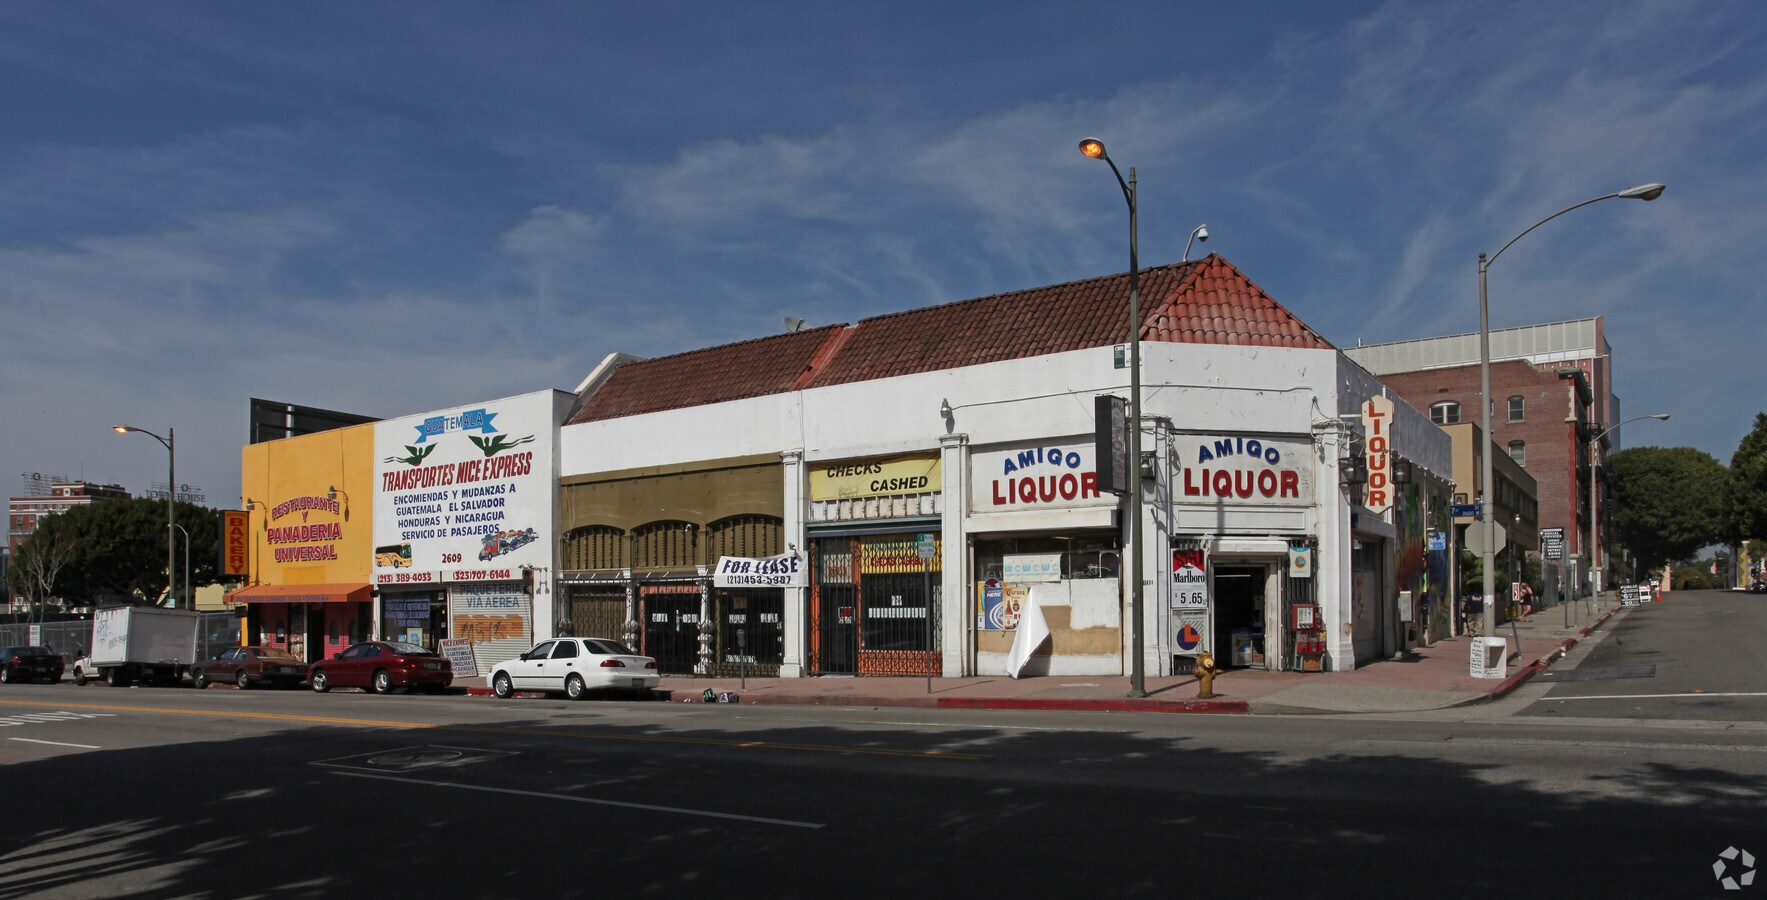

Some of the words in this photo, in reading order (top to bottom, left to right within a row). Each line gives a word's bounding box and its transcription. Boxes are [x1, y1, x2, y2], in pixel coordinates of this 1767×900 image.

[425, 412, 483, 433] GUATEMALA
[1198, 437, 1280, 464] AMIGO
[1368, 402, 1386, 506] LIQUOR
[827, 462, 882, 478] CHECKS
[1003, 447, 1081, 475] AMIGO
[382, 463, 456, 492] TRANSPORTES
[456, 459, 482, 487] NICE
[483, 451, 533, 481] EXPRESS
[870, 476, 928, 492] CASHED
[992, 471, 1101, 506] LIQUOR
[1184, 468, 1299, 499] LIQUOR
[177, 493, 206, 502] HOUSE
[394, 491, 448, 505] ENCOMIENDAS
[452, 490, 458, 500] Y
[461, 484, 505, 498] MUDANZAS
[509, 484, 516, 493] A
[271, 496, 340, 521] RESTAURANTE
[396, 504, 442, 516] GUATEMALA
[449, 502, 459, 512] EL
[461, 498, 505, 511] SALVADOR
[302, 511, 309, 522] Y
[398, 516, 440, 528] HONDURAS
[444, 516, 451, 525] Y
[455, 511, 505, 523] NICARAGUA
[267, 522, 342, 545] PANADERIA
[402, 529, 435, 540] SERVICIO
[437, 528, 447, 538] DE
[451, 523, 500, 537] PASAJEROS
[230, 517, 244, 573] BAKERY
[274, 544, 337, 563] UNIVERSAL
[442, 553, 462, 564] 2609
[722, 559, 751, 574] FOR
[754, 556, 798, 575] LEASE
[377, 574, 393, 583] (213)
[396, 572, 432, 583] 389-4033
[453, 569, 511, 580] (323)707-6144
[1173, 570, 1205, 583] Marlboro
[460, 583, 522, 596] PAQUETERIA
[485, 596, 520, 608] AEREA
